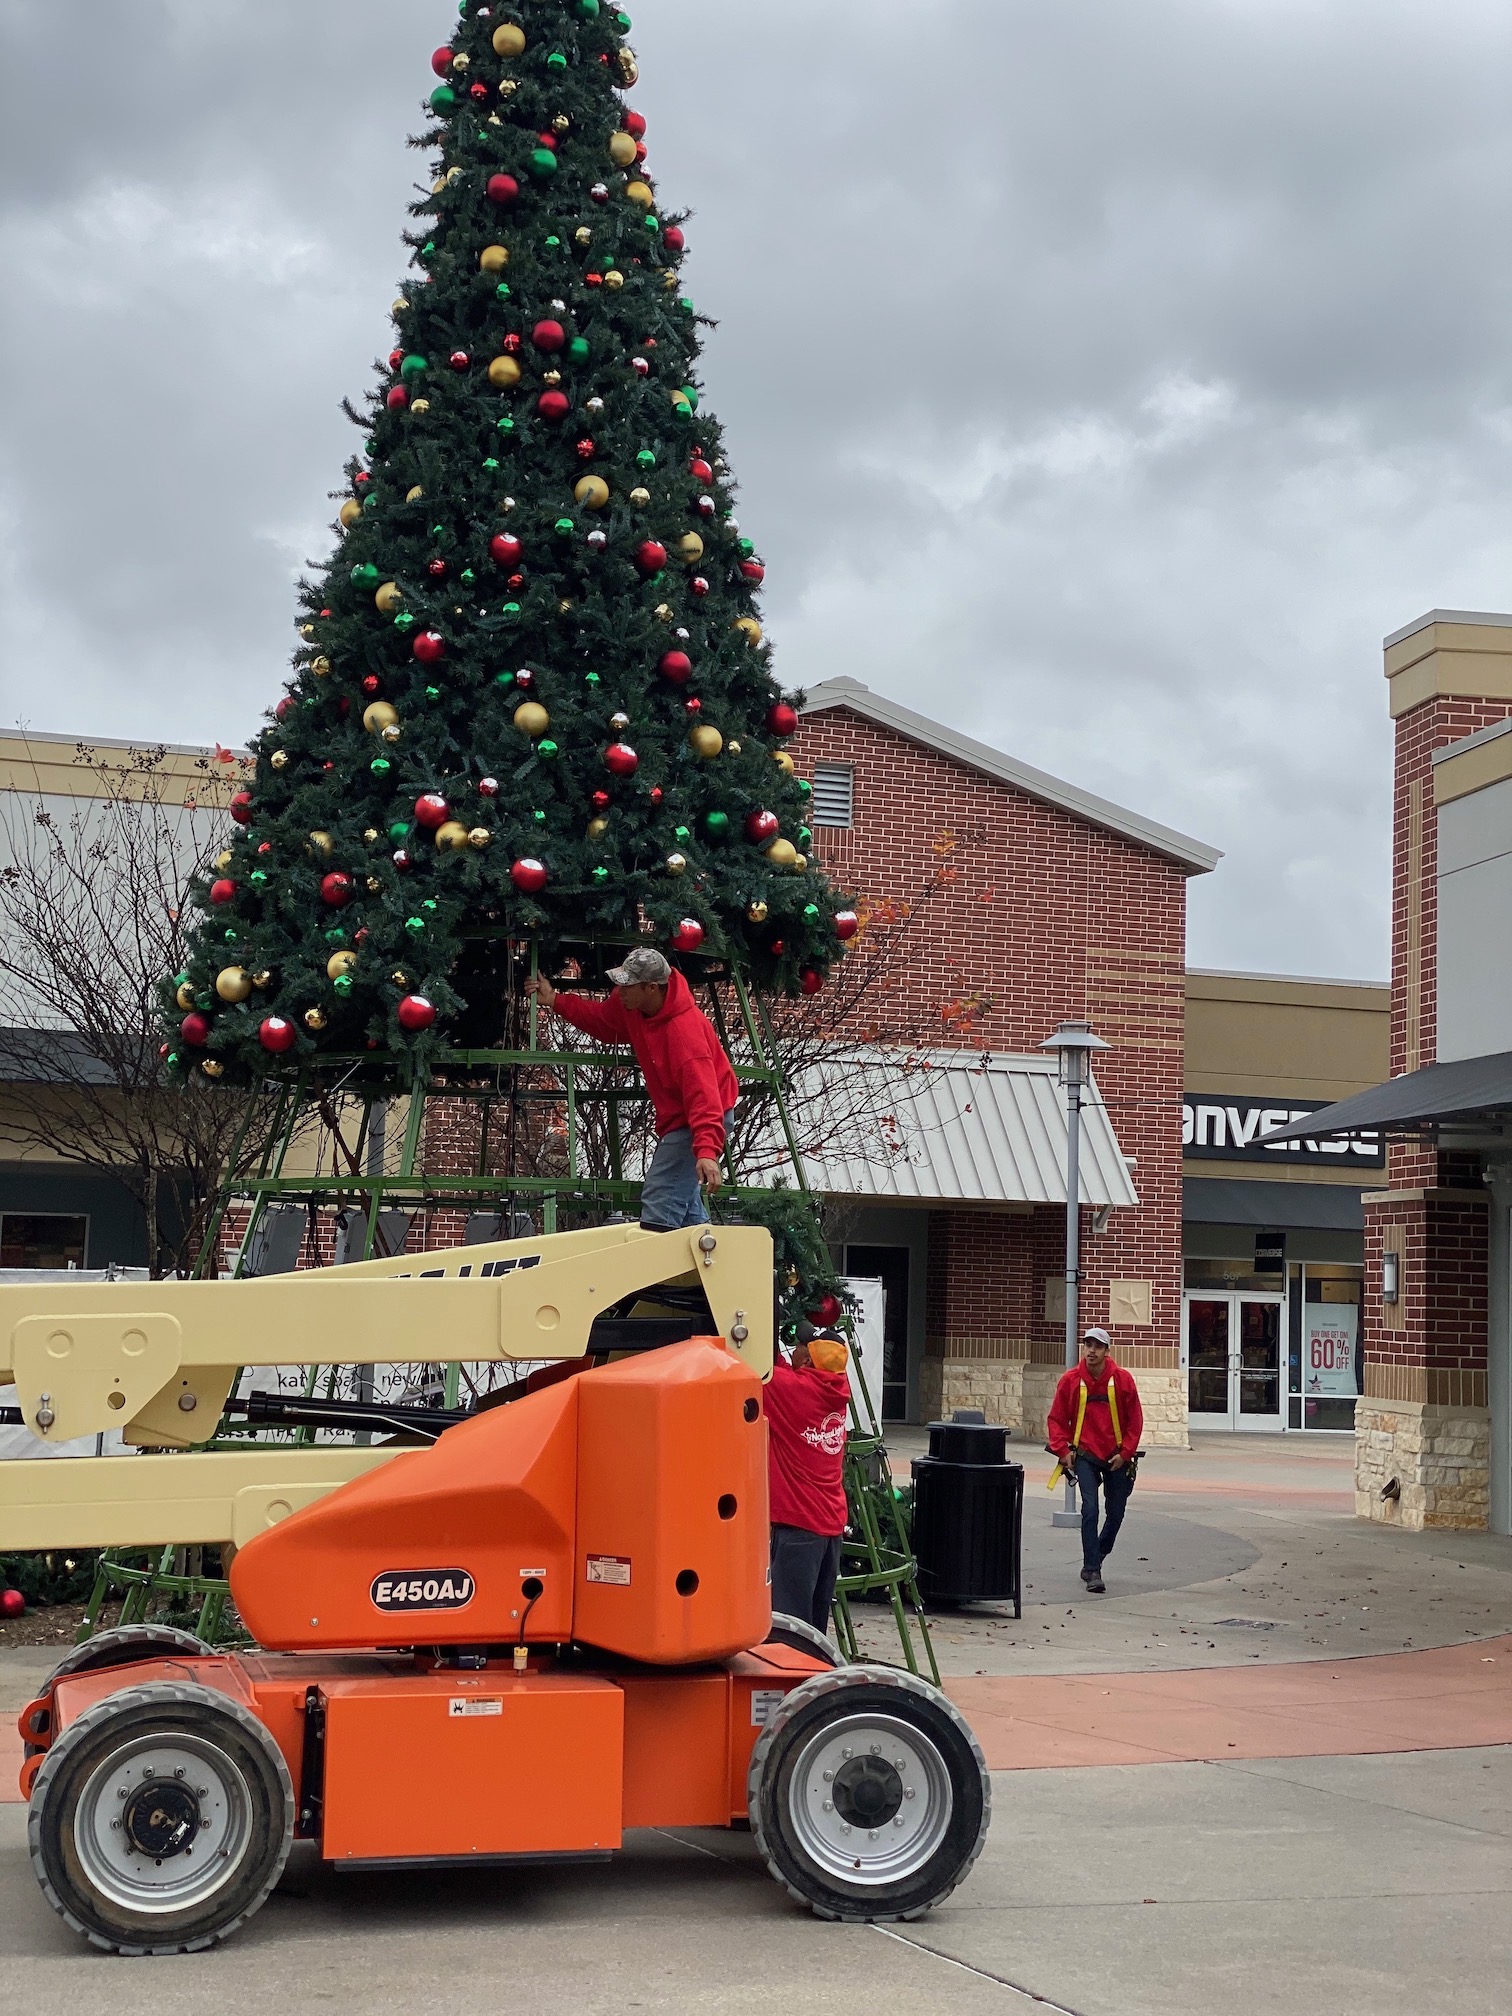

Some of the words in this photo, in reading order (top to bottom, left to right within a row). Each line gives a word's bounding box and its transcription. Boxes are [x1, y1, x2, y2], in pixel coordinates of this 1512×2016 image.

[1311, 1330, 1320, 1338] BUY
[1321, 1330, 1330, 1338] ONE
[1331, 1330, 1340, 1339] GET
[1340, 1331, 1349, 1339] ONE
[1336, 1356, 1349, 1370] OFF
[278, 1373, 306, 1388] kat
[376, 1578, 470, 1603] E450AJ
